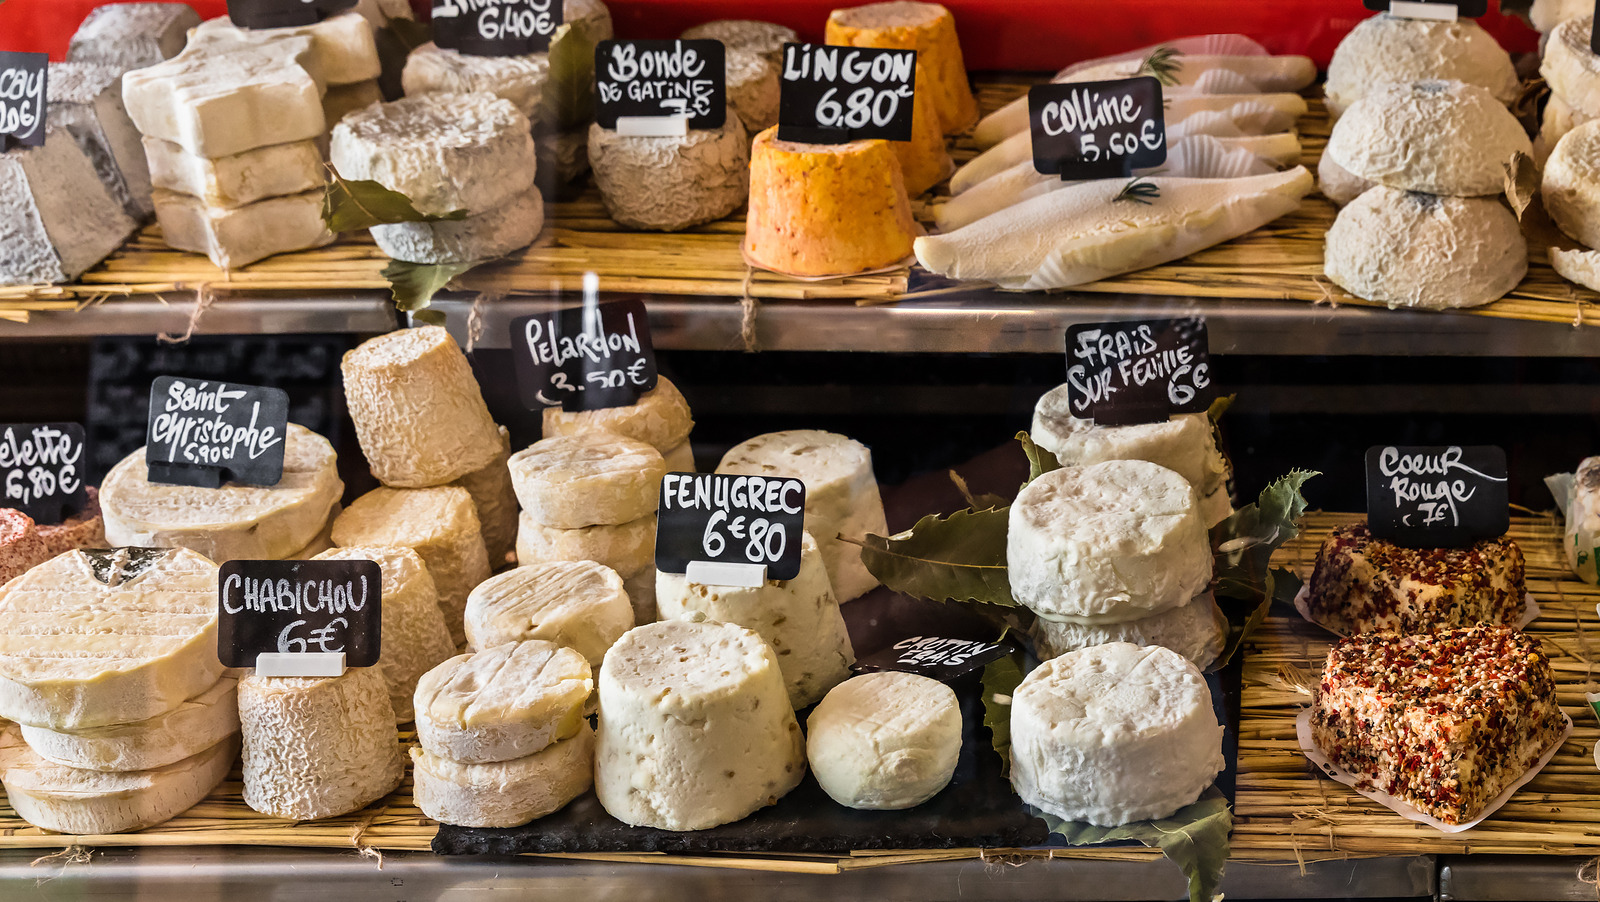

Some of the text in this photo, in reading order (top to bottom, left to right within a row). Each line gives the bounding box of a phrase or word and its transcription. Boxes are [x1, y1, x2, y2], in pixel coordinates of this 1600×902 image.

[477, 6, 555, 39] 6,40€
[608, 39, 706, 82] Bonde
[598, 81, 623, 104] DE
[1080, 119, 1163, 162] 5,60€
[1066, 364, 1118, 412] SUR
[1167, 363, 1211, 406] 6€
[663, 474, 802, 515] FENUGREC
[222, 573, 368, 615] CHABICHOU
[277, 616, 349, 653] 6€
